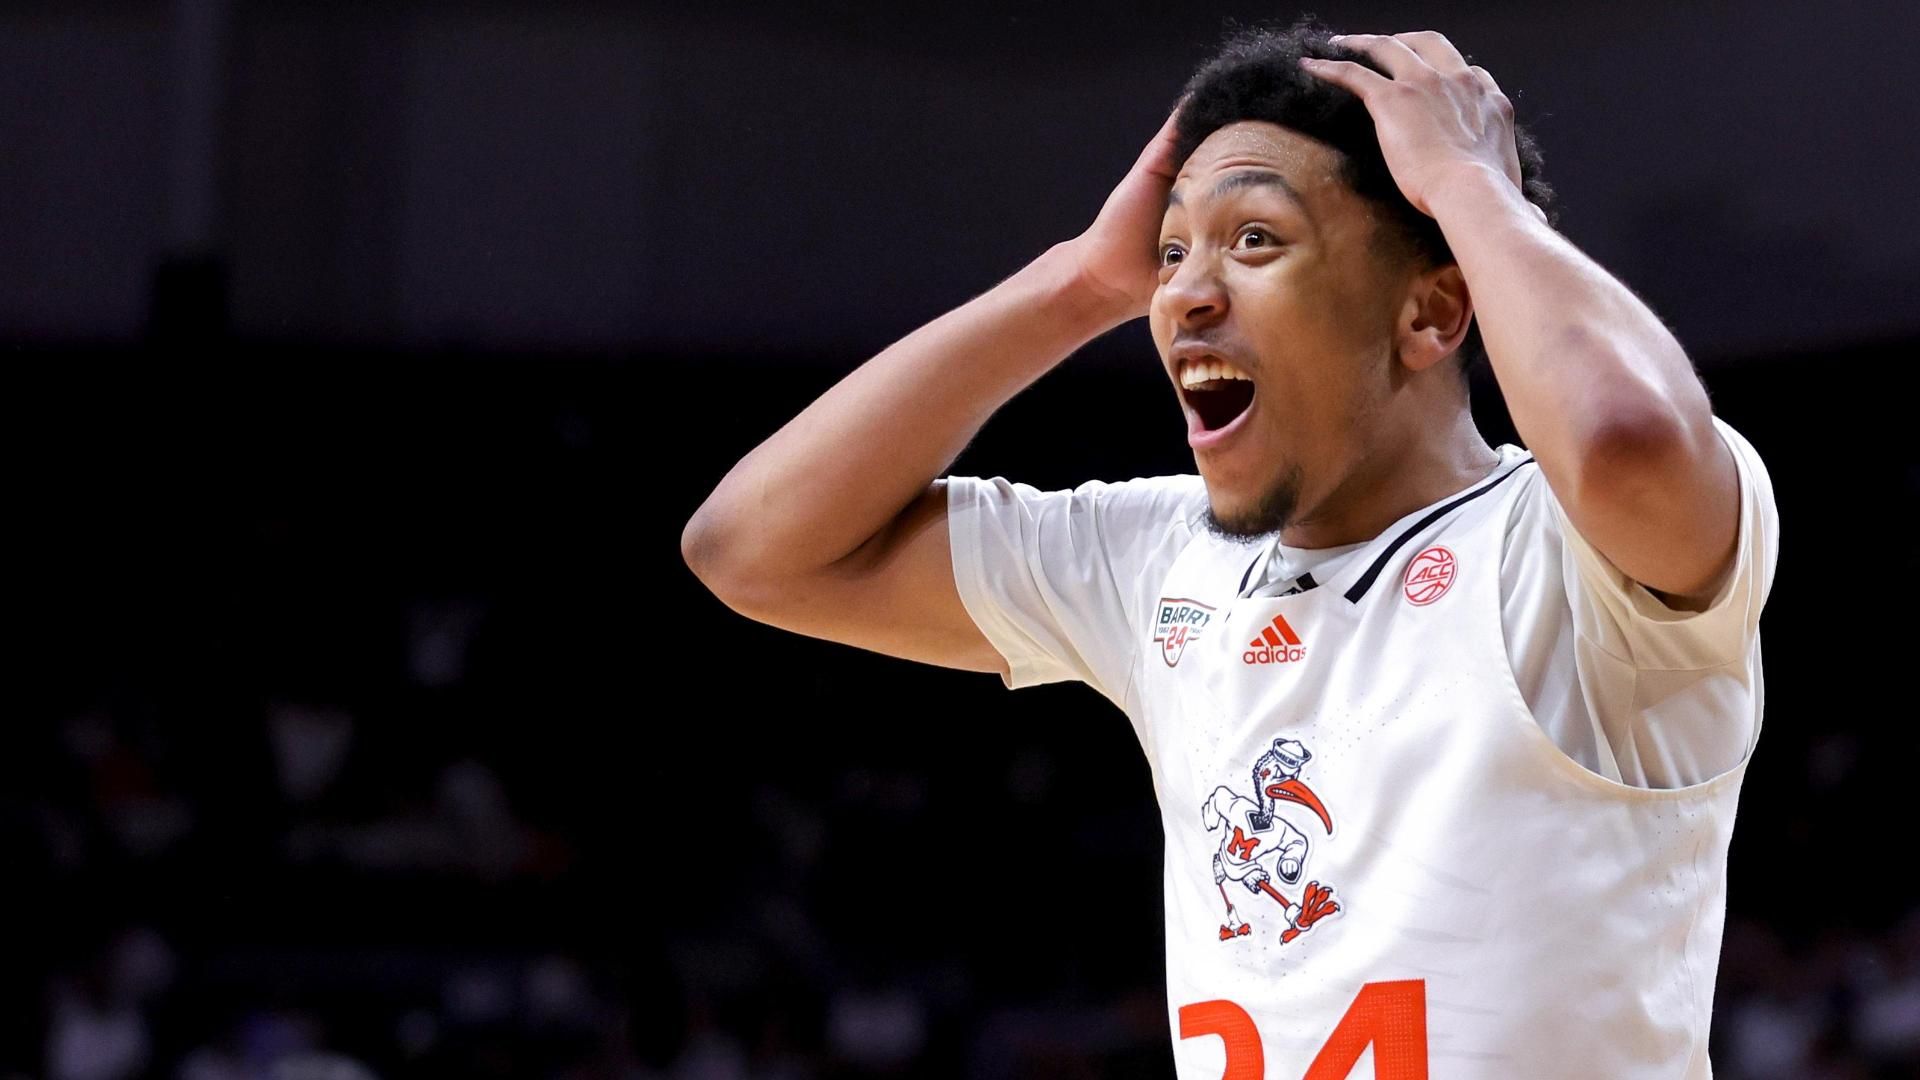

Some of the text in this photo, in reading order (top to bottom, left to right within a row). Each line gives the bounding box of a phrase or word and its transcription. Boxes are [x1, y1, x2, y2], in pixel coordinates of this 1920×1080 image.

[1411, 562, 1453, 582] ACC
[1160, 607, 1211, 627] BARRY
[1166, 626, 1188, 649] 24
[1243, 645, 1307, 665] adidas
[1227, 826, 1261, 861] M
